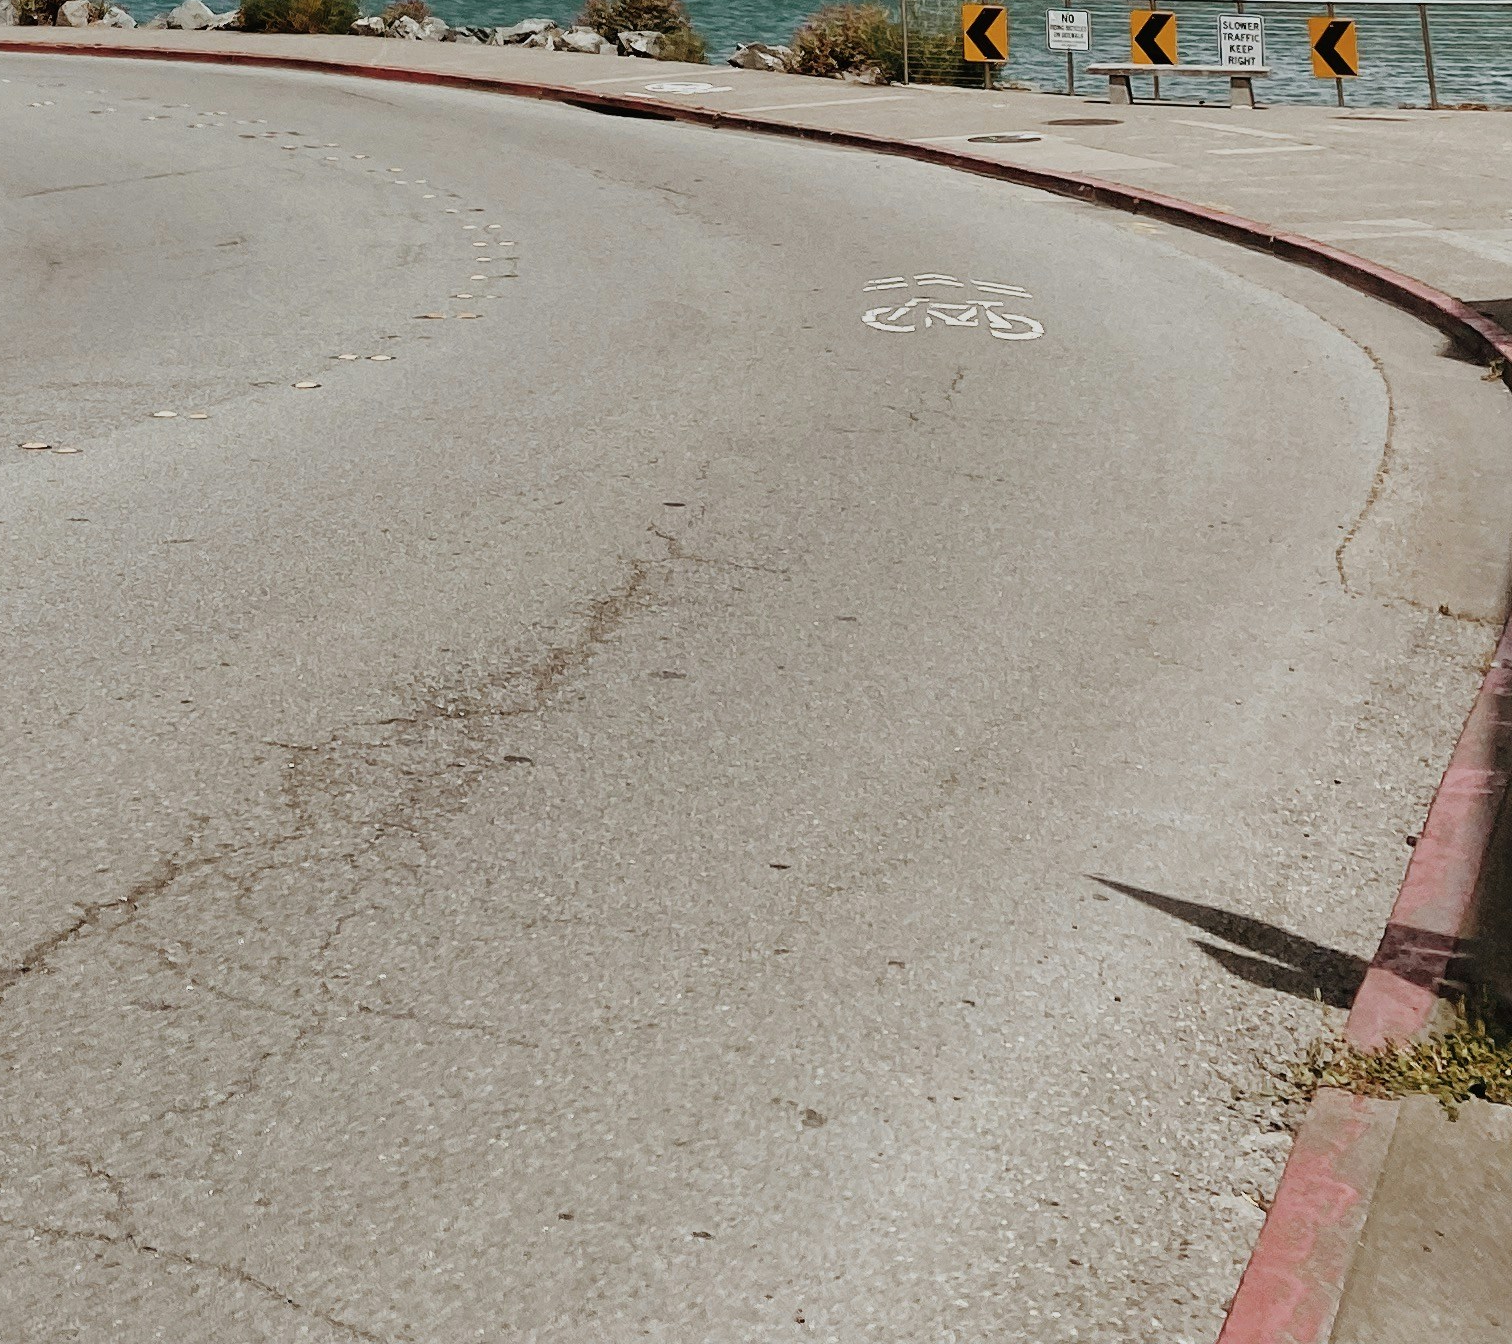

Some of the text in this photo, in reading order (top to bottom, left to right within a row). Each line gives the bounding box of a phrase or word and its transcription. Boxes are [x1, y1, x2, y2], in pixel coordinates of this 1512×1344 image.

[1061, 13, 1075, 24] NO
[1222, 21, 1259, 31] SLOWER
[1223, 32, 1260, 43] TRAFFIC
[1229, 44, 1254, 54] KEEP
[1228, 55, 1256, 66] RIGHT
